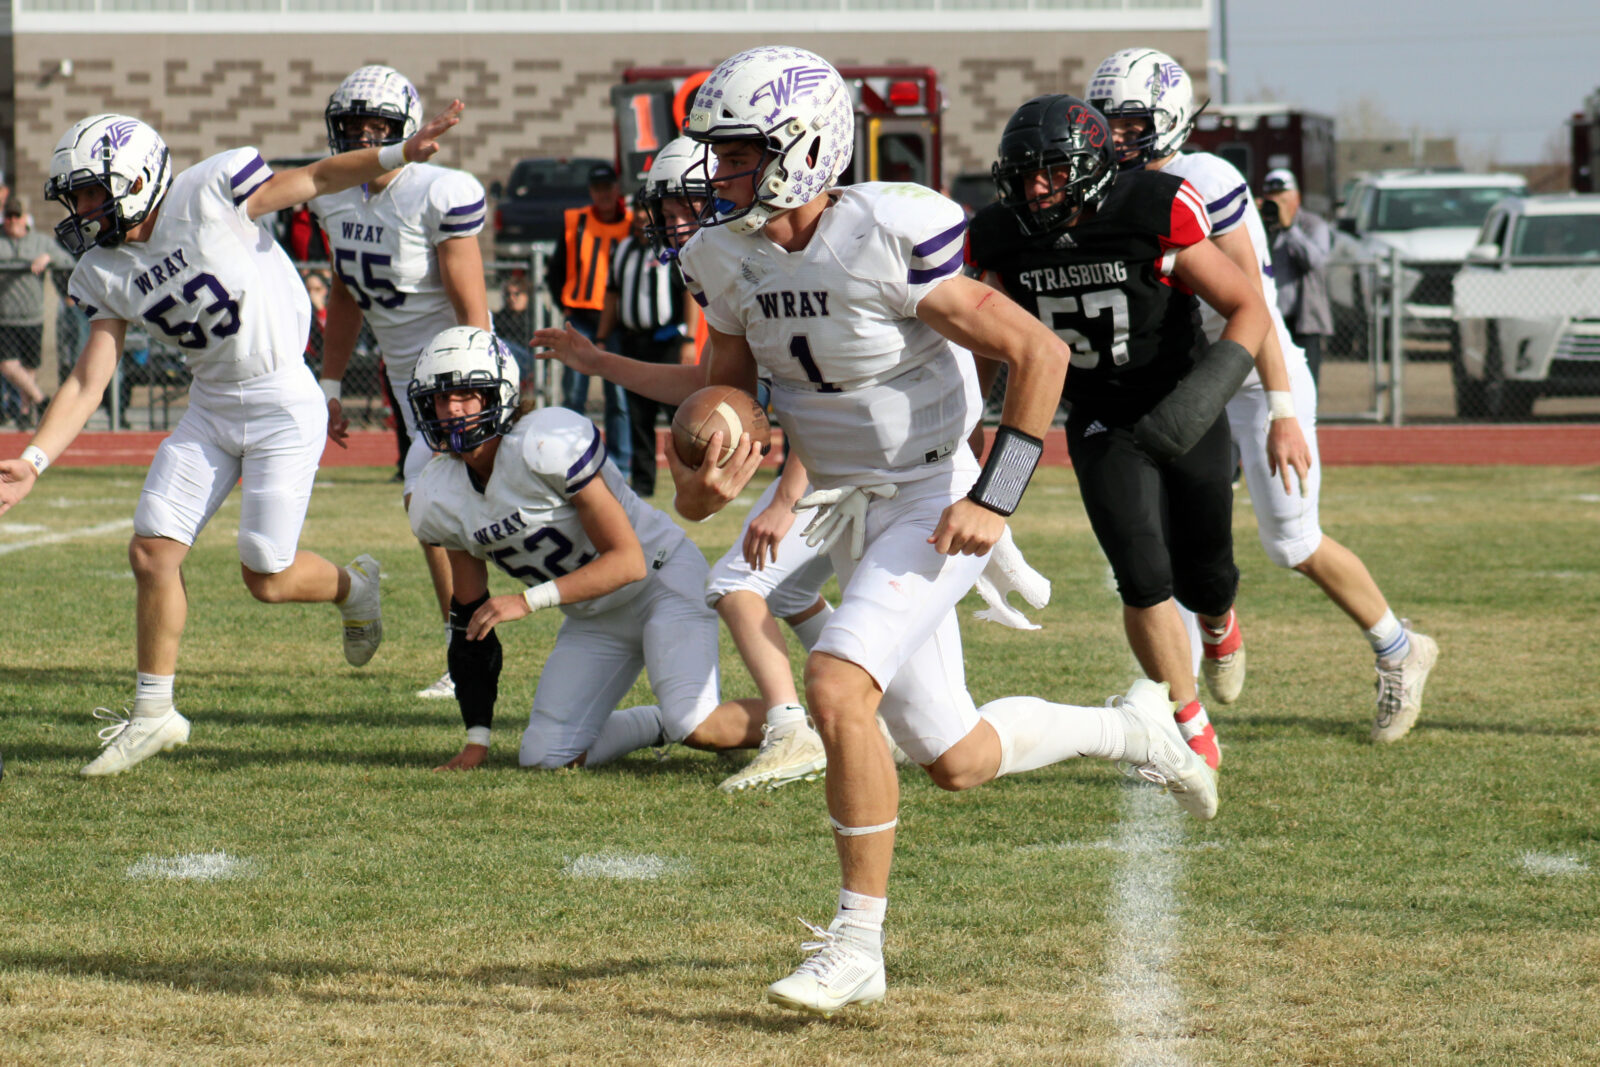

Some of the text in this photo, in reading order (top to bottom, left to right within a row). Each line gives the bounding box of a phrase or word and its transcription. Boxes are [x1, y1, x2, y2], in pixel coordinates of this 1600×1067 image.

[630, 93, 659, 152] 1
[341, 221, 384, 244] WRAY
[134, 247, 189, 296] WRAY
[335, 248, 407, 311] 55
[1019, 260, 1128, 293] STRASBURG
[142, 272, 241, 349] 53
[756, 290, 830, 319] WRAY
[1036, 288, 1130, 370] 57
[789, 332, 844, 393] 1
[473, 511, 529, 546] WRAY
[485, 526, 598, 588] 52
